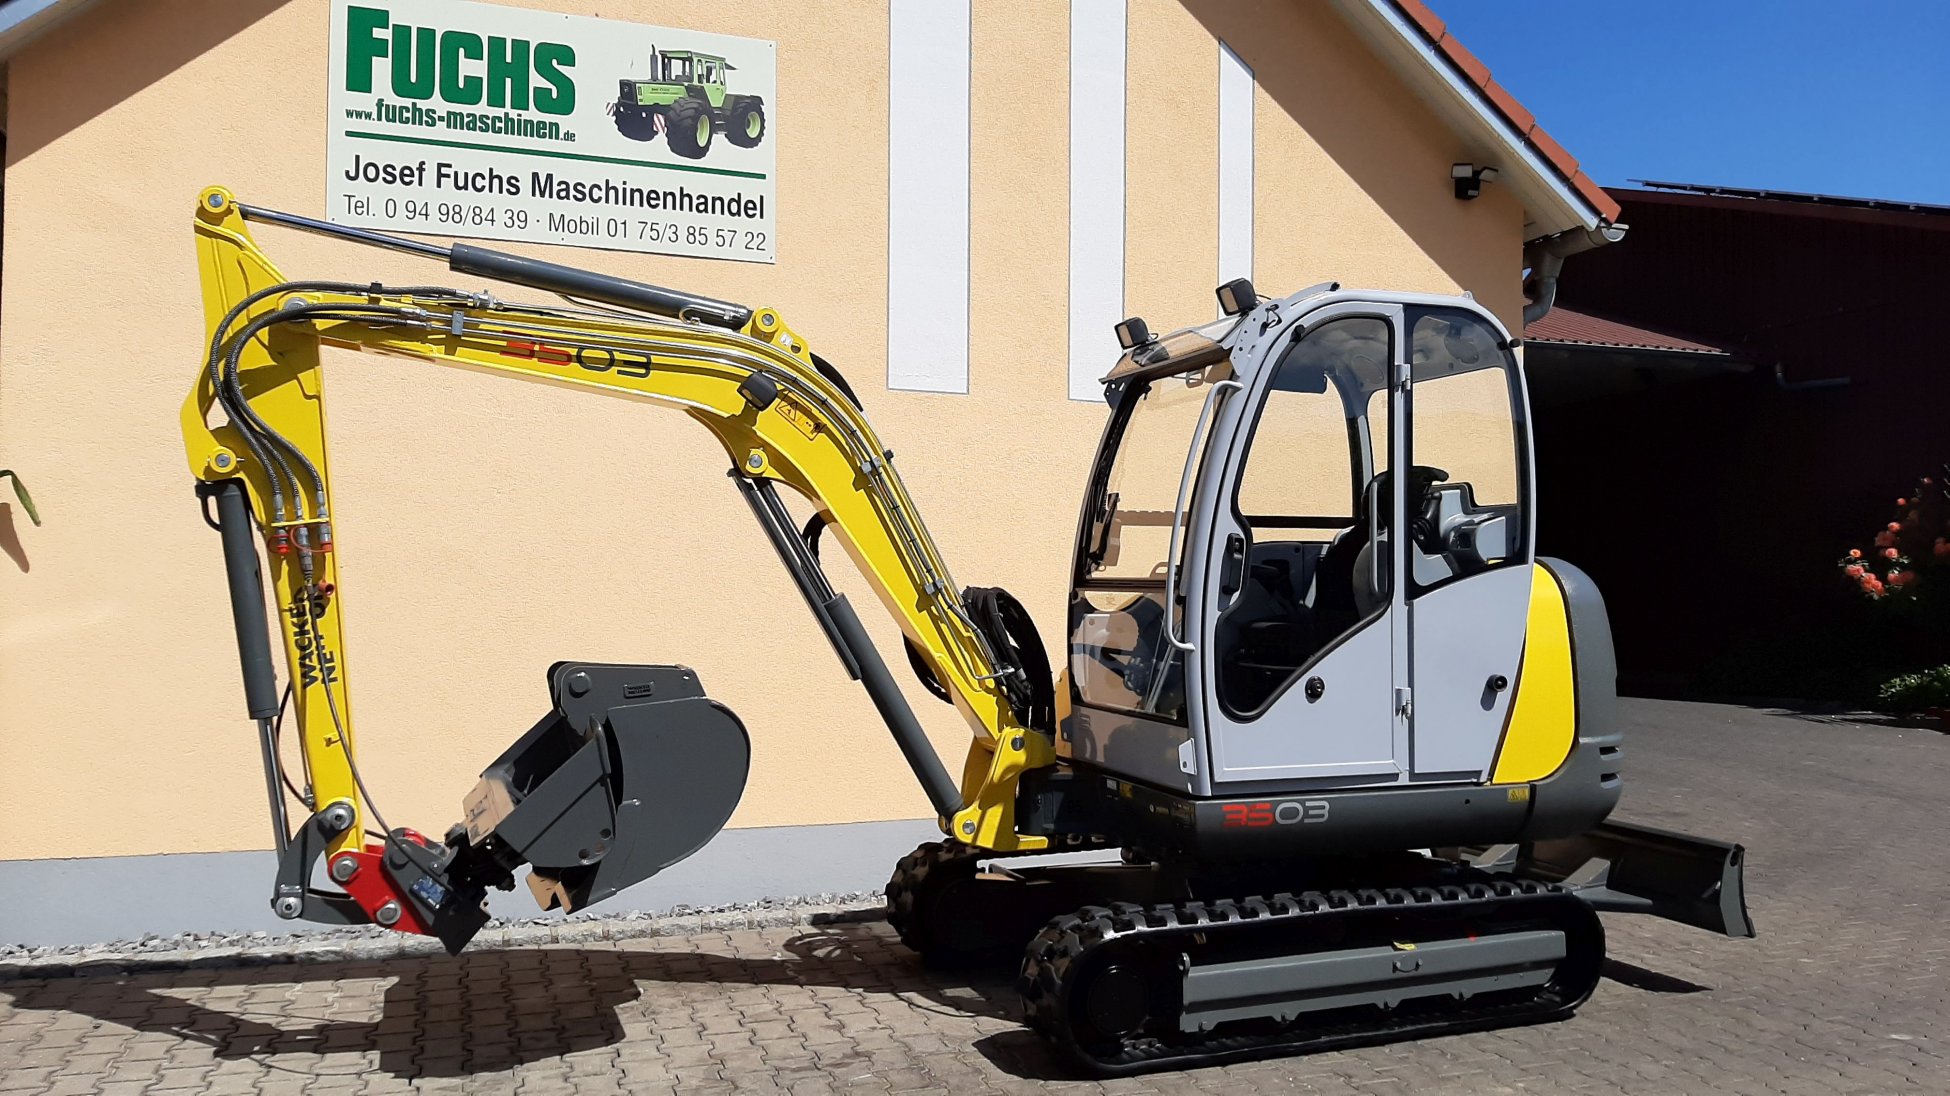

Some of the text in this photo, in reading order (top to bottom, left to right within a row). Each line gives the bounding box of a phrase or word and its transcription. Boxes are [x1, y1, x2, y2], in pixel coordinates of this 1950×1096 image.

[346, 5, 576, 116] FUCHS
[345, 98, 576, 142] www.fuchs-maschinen.de
[344, 154, 764, 219] Josef Fuchs Maschinenhandel
[343, 194, 767, 252] Tel. 0 94 98/84 39 Mobil 01 75/3 85 57 22
[1222, 800, 1330, 827] 3503
